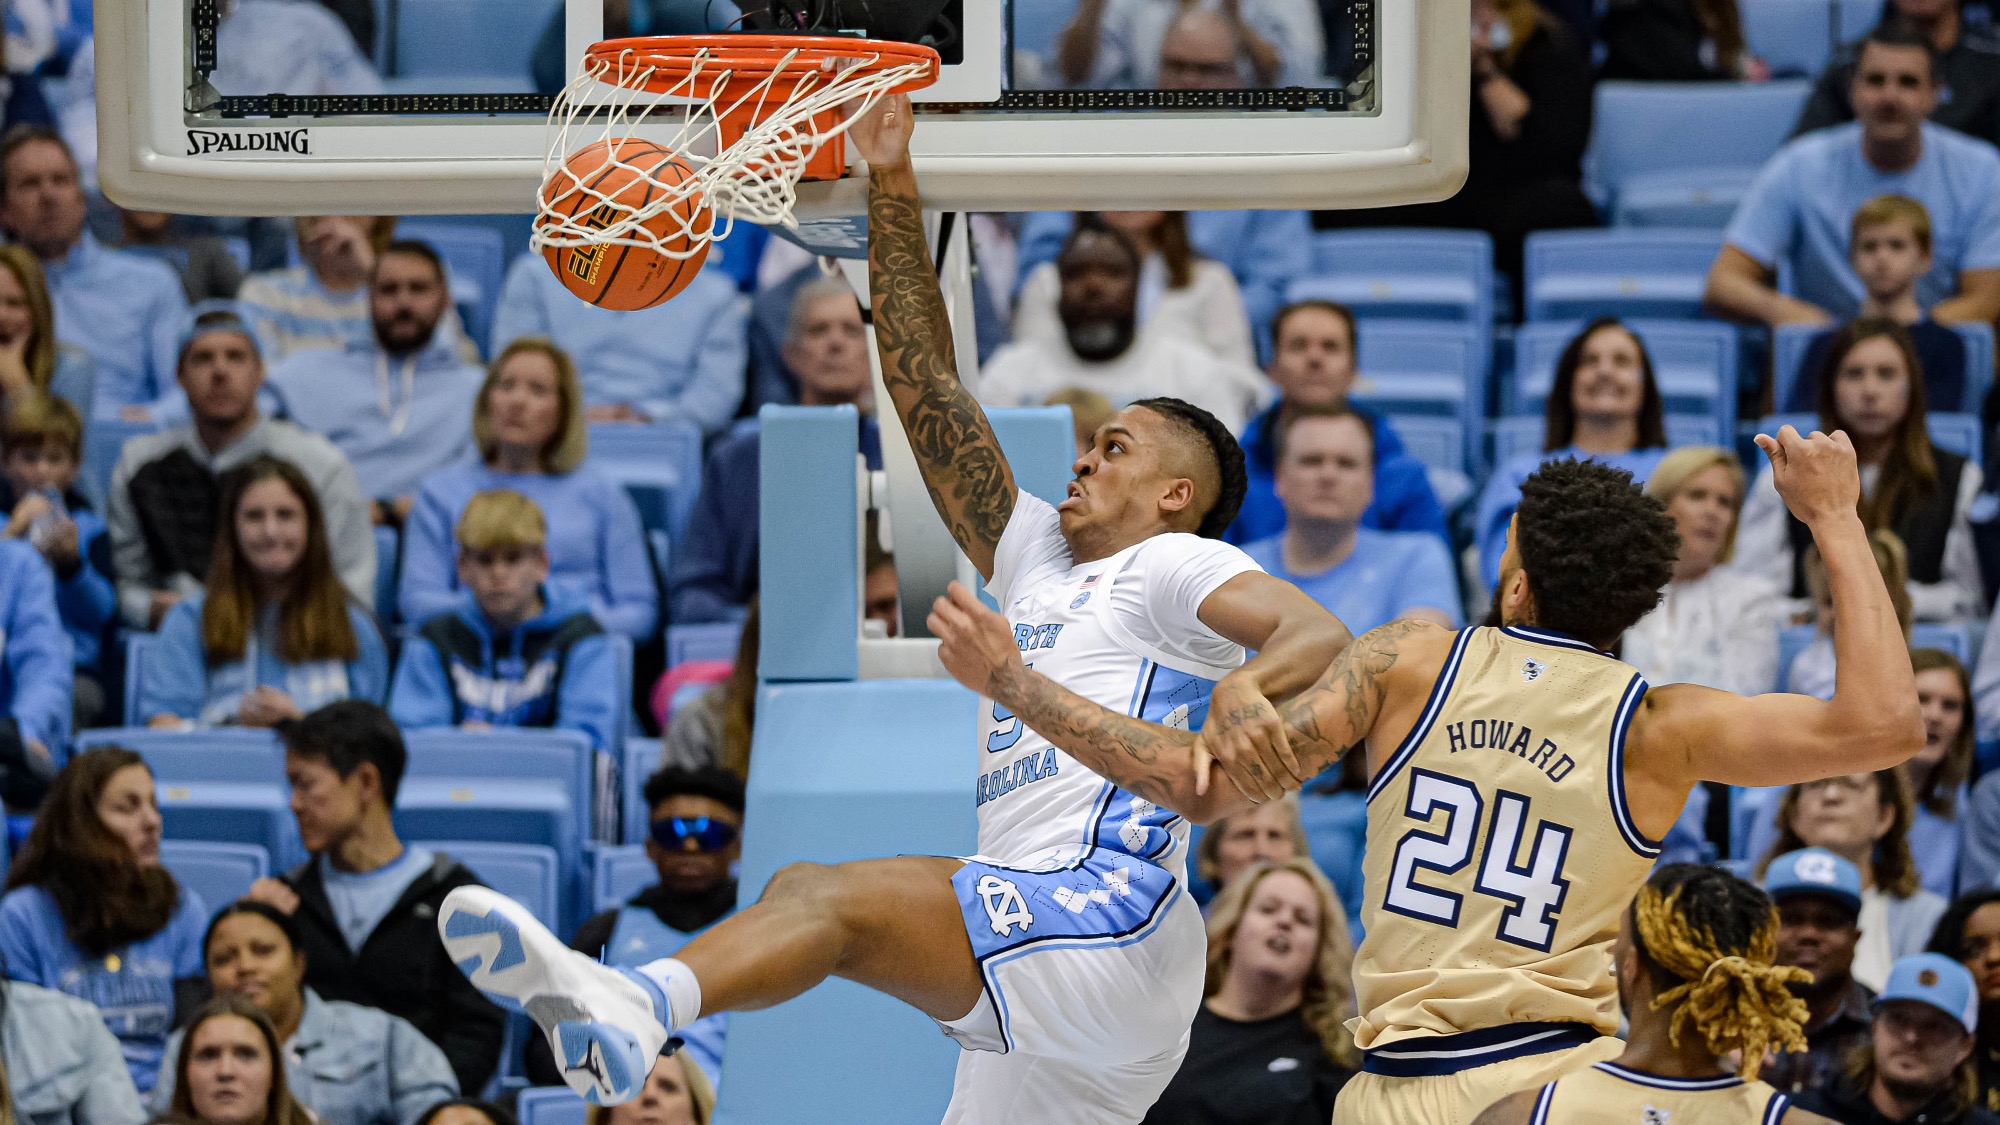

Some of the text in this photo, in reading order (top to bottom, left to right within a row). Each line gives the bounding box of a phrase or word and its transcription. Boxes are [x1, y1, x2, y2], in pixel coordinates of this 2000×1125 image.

[186, 128, 309, 156] SPALDING
[567, 193, 620, 282] ELTE
[1013, 623, 1064, 652] RTH
[976, 747, 1059, 808] ROLINA
[1446, 719, 1575, 783] HOWARD
[1382, 766, 1574, 954] 24
